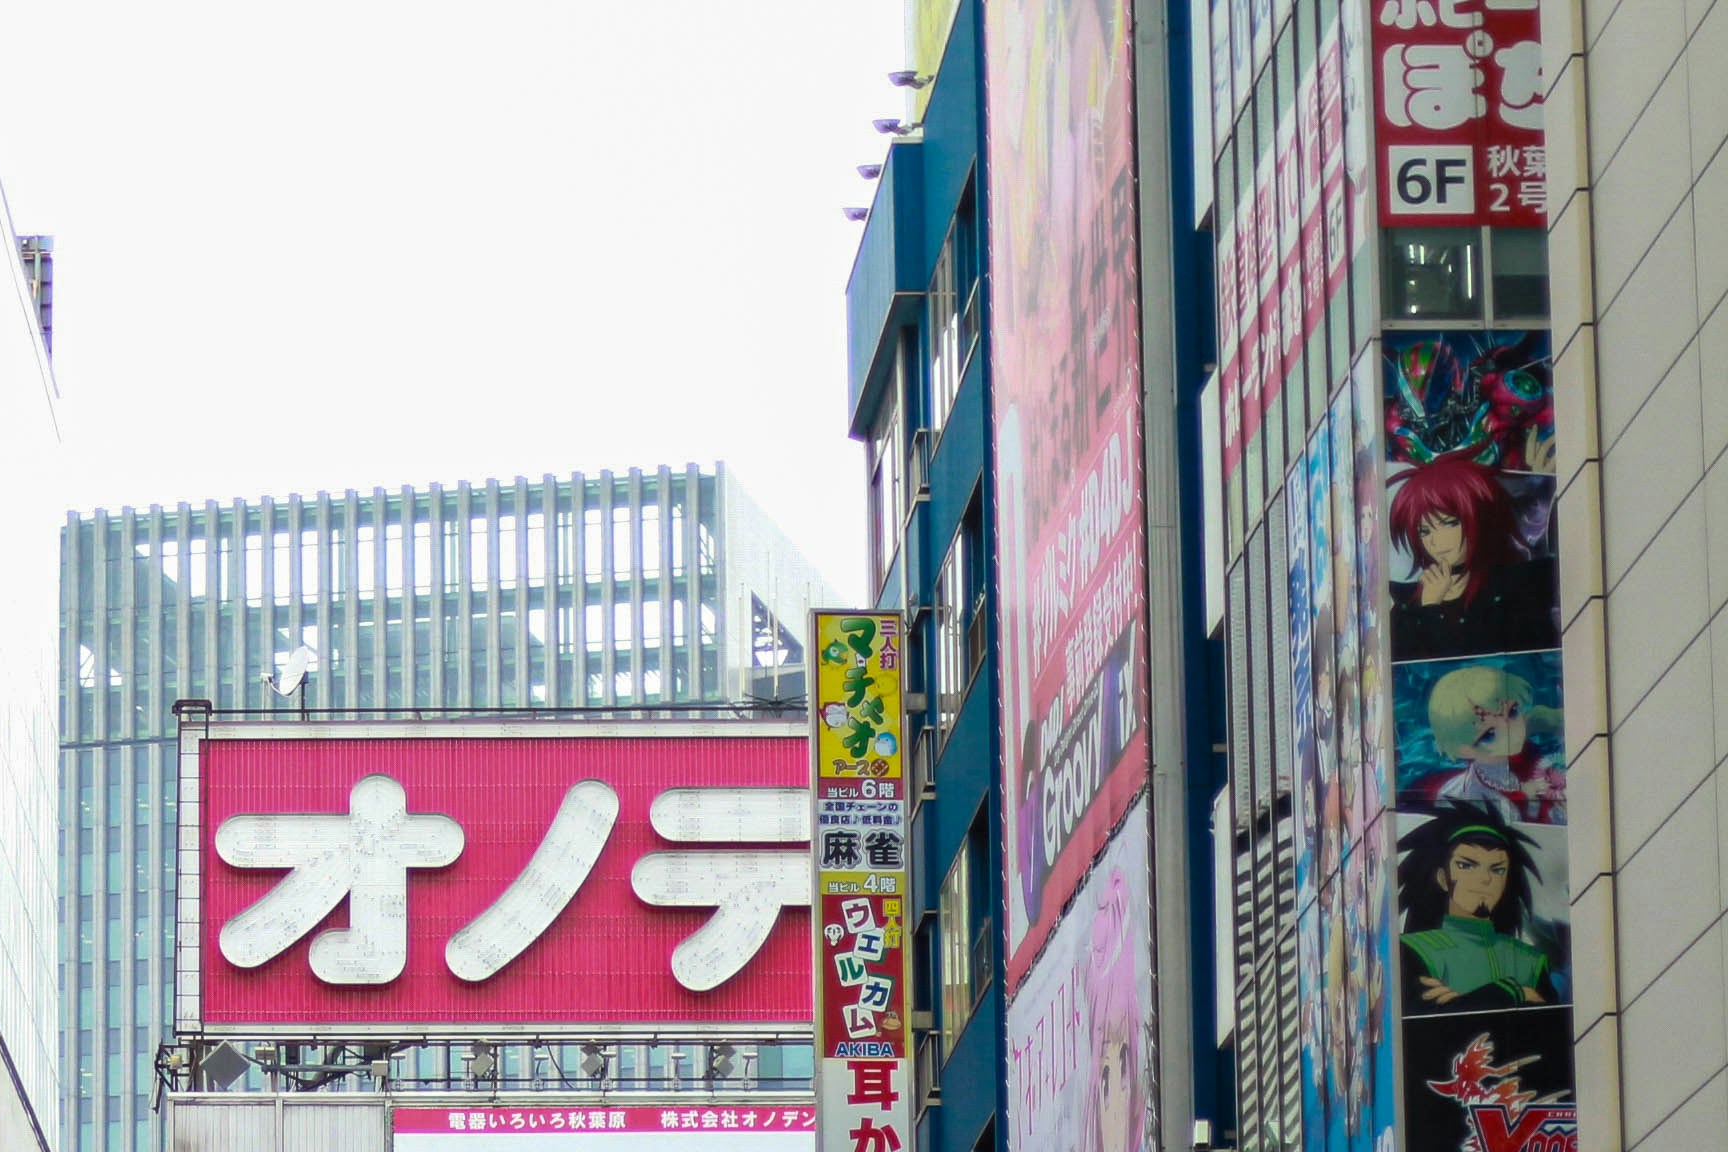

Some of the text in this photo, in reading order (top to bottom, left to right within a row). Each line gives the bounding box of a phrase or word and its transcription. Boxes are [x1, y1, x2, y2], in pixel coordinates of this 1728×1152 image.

[1396, 158, 1467, 205] 6F
[879, 619, 897, 671] 三人打
[822, 831, 903, 867] 麻雀
[835, 1042, 895, 1058] AKIBA
[447, 1111, 627, 1130] 電器いろいろ秋葉原
